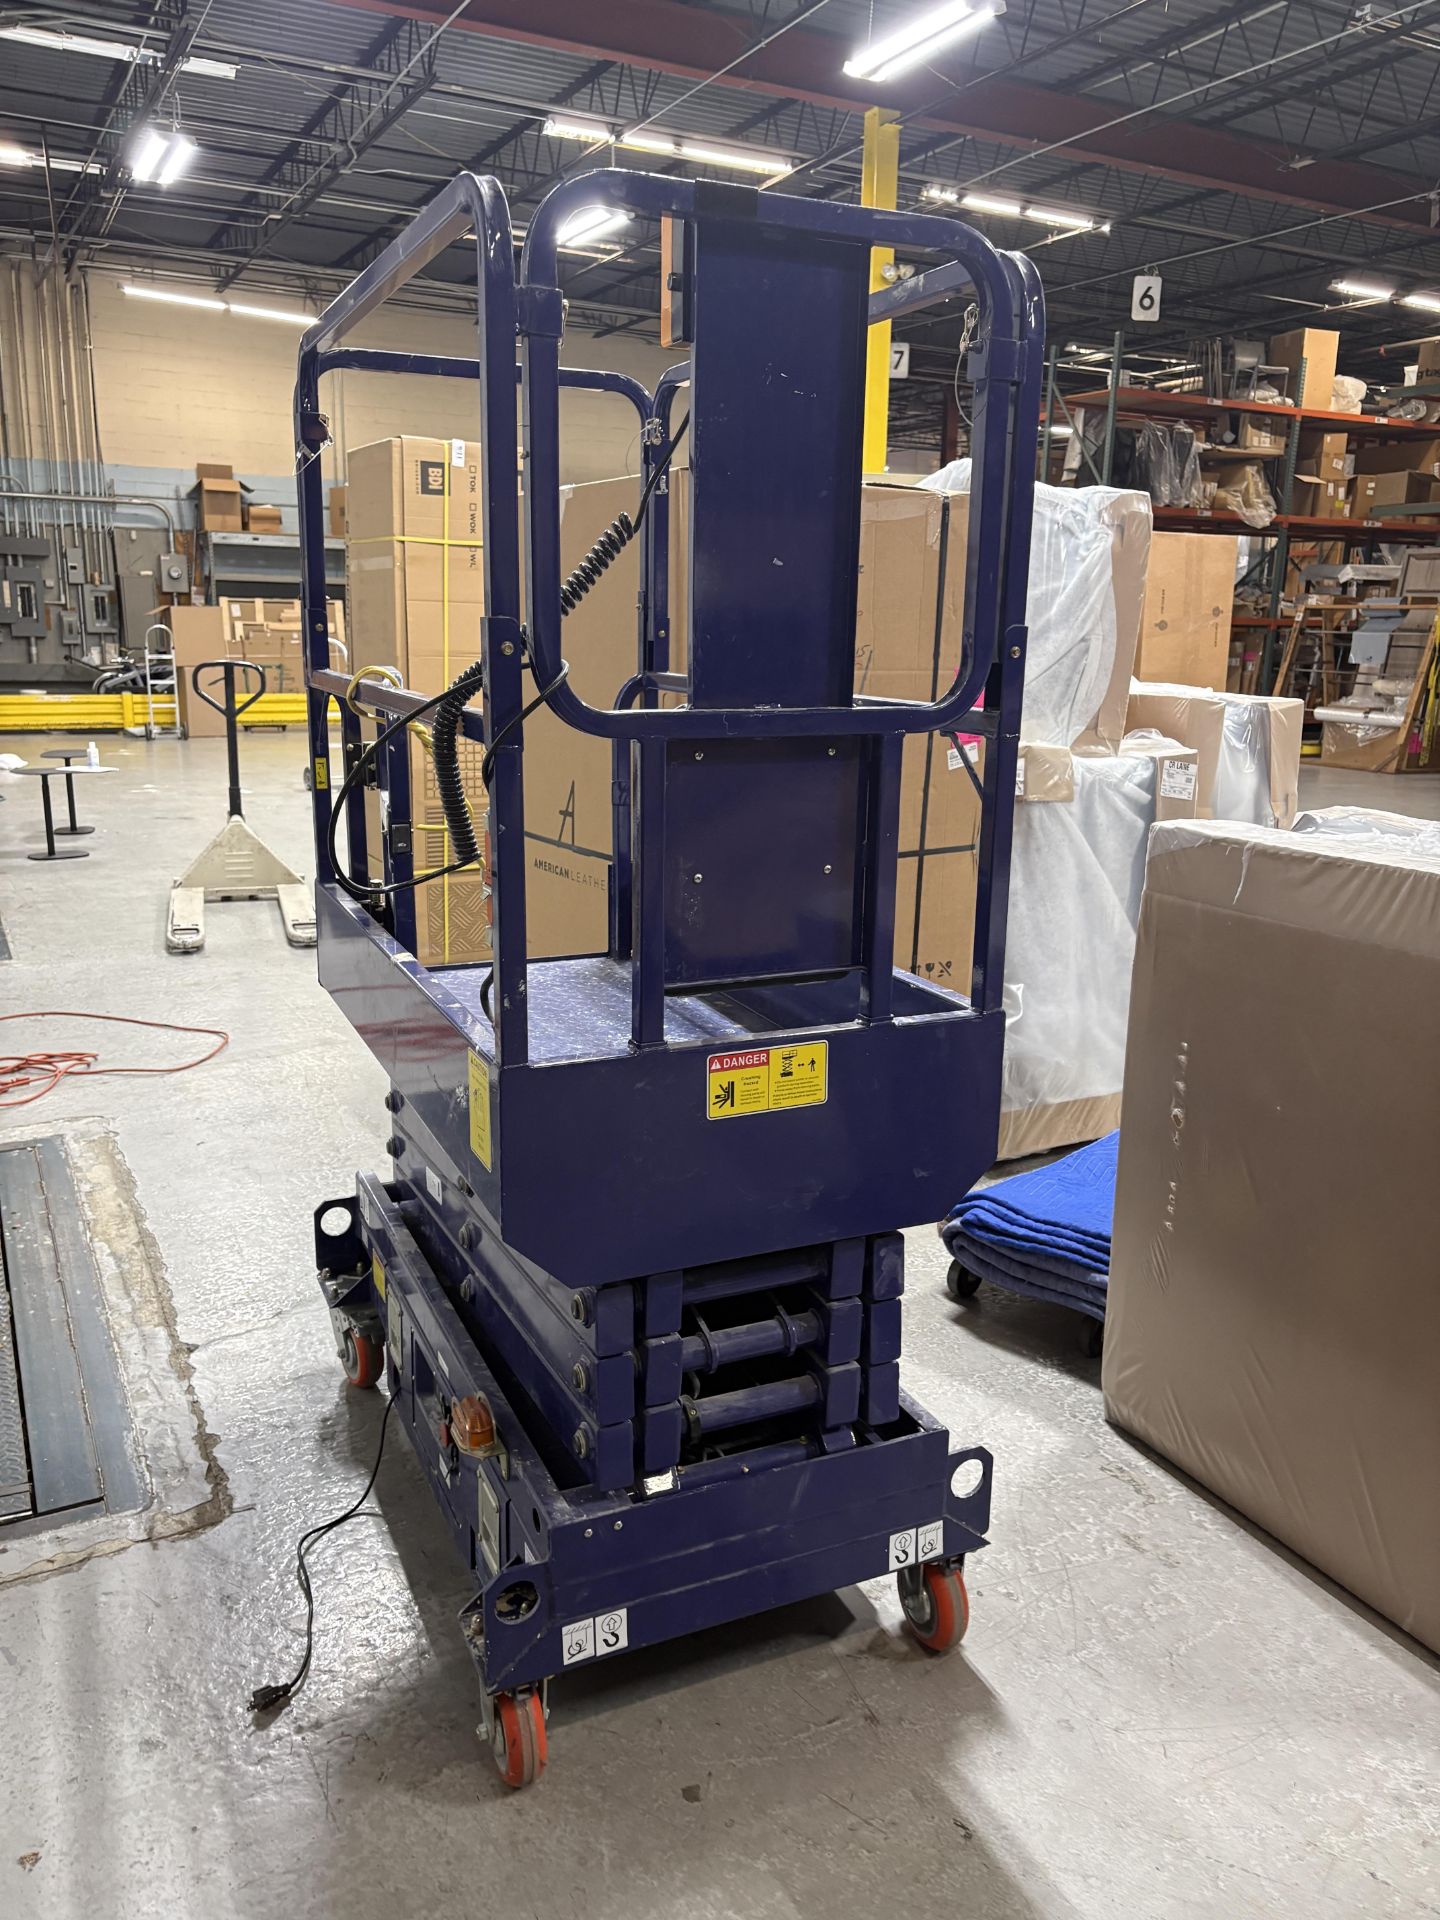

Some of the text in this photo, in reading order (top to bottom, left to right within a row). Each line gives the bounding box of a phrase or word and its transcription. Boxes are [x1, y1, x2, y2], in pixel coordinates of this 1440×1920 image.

[1139, 286, 1155, 311] 6
[893, 350, 905, 370] 7
[428, 467, 444, 490] BDI
[469, 475, 477, 493] TOK
[469, 513, 477, 534] WOK
[534, 858, 607, 891] AMERICAN LEATHE
[723, 1053, 768, 1069] DANGER
